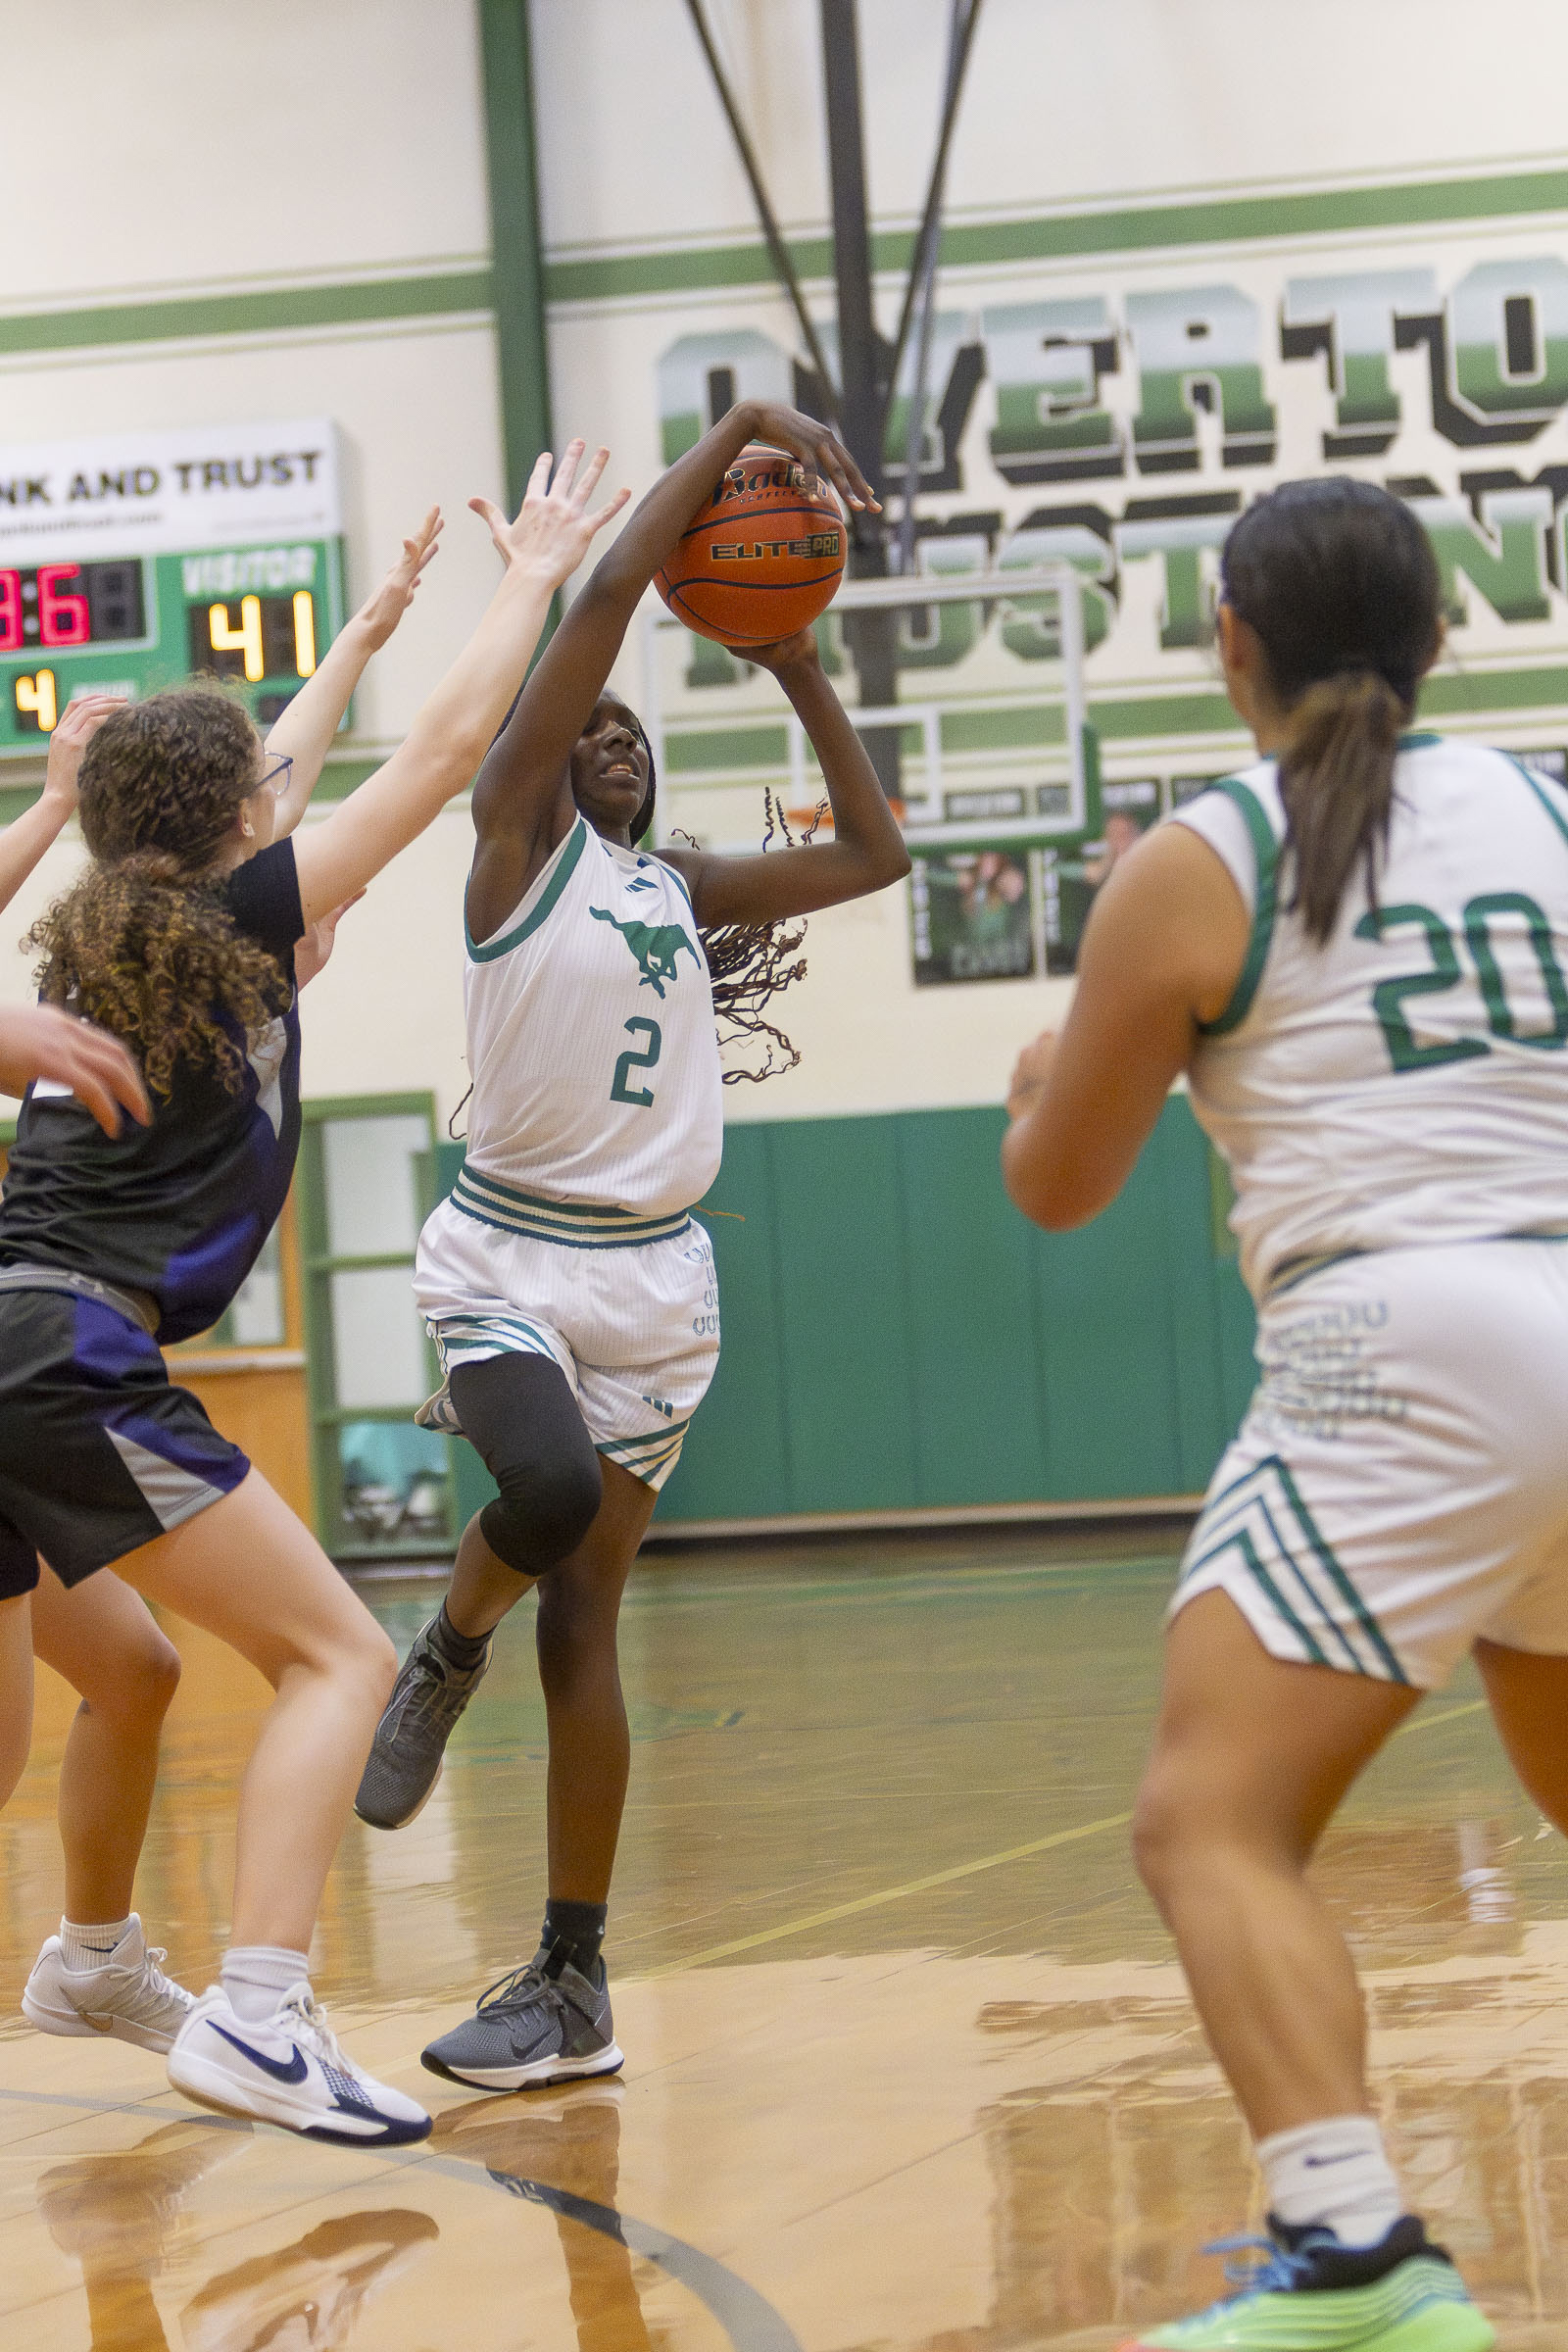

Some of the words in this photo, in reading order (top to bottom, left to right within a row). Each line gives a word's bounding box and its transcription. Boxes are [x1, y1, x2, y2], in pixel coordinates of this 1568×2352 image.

[67, 466, 161, 504] AND
[172, 449, 322, 493] TRUST
[710, 539, 811, 561] ELITE
[209, 590, 317, 682] 41
[15, 668, 57, 732] 4
[1353, 893, 1568, 1074] 20
[610, 1016, 662, 1108] 2
